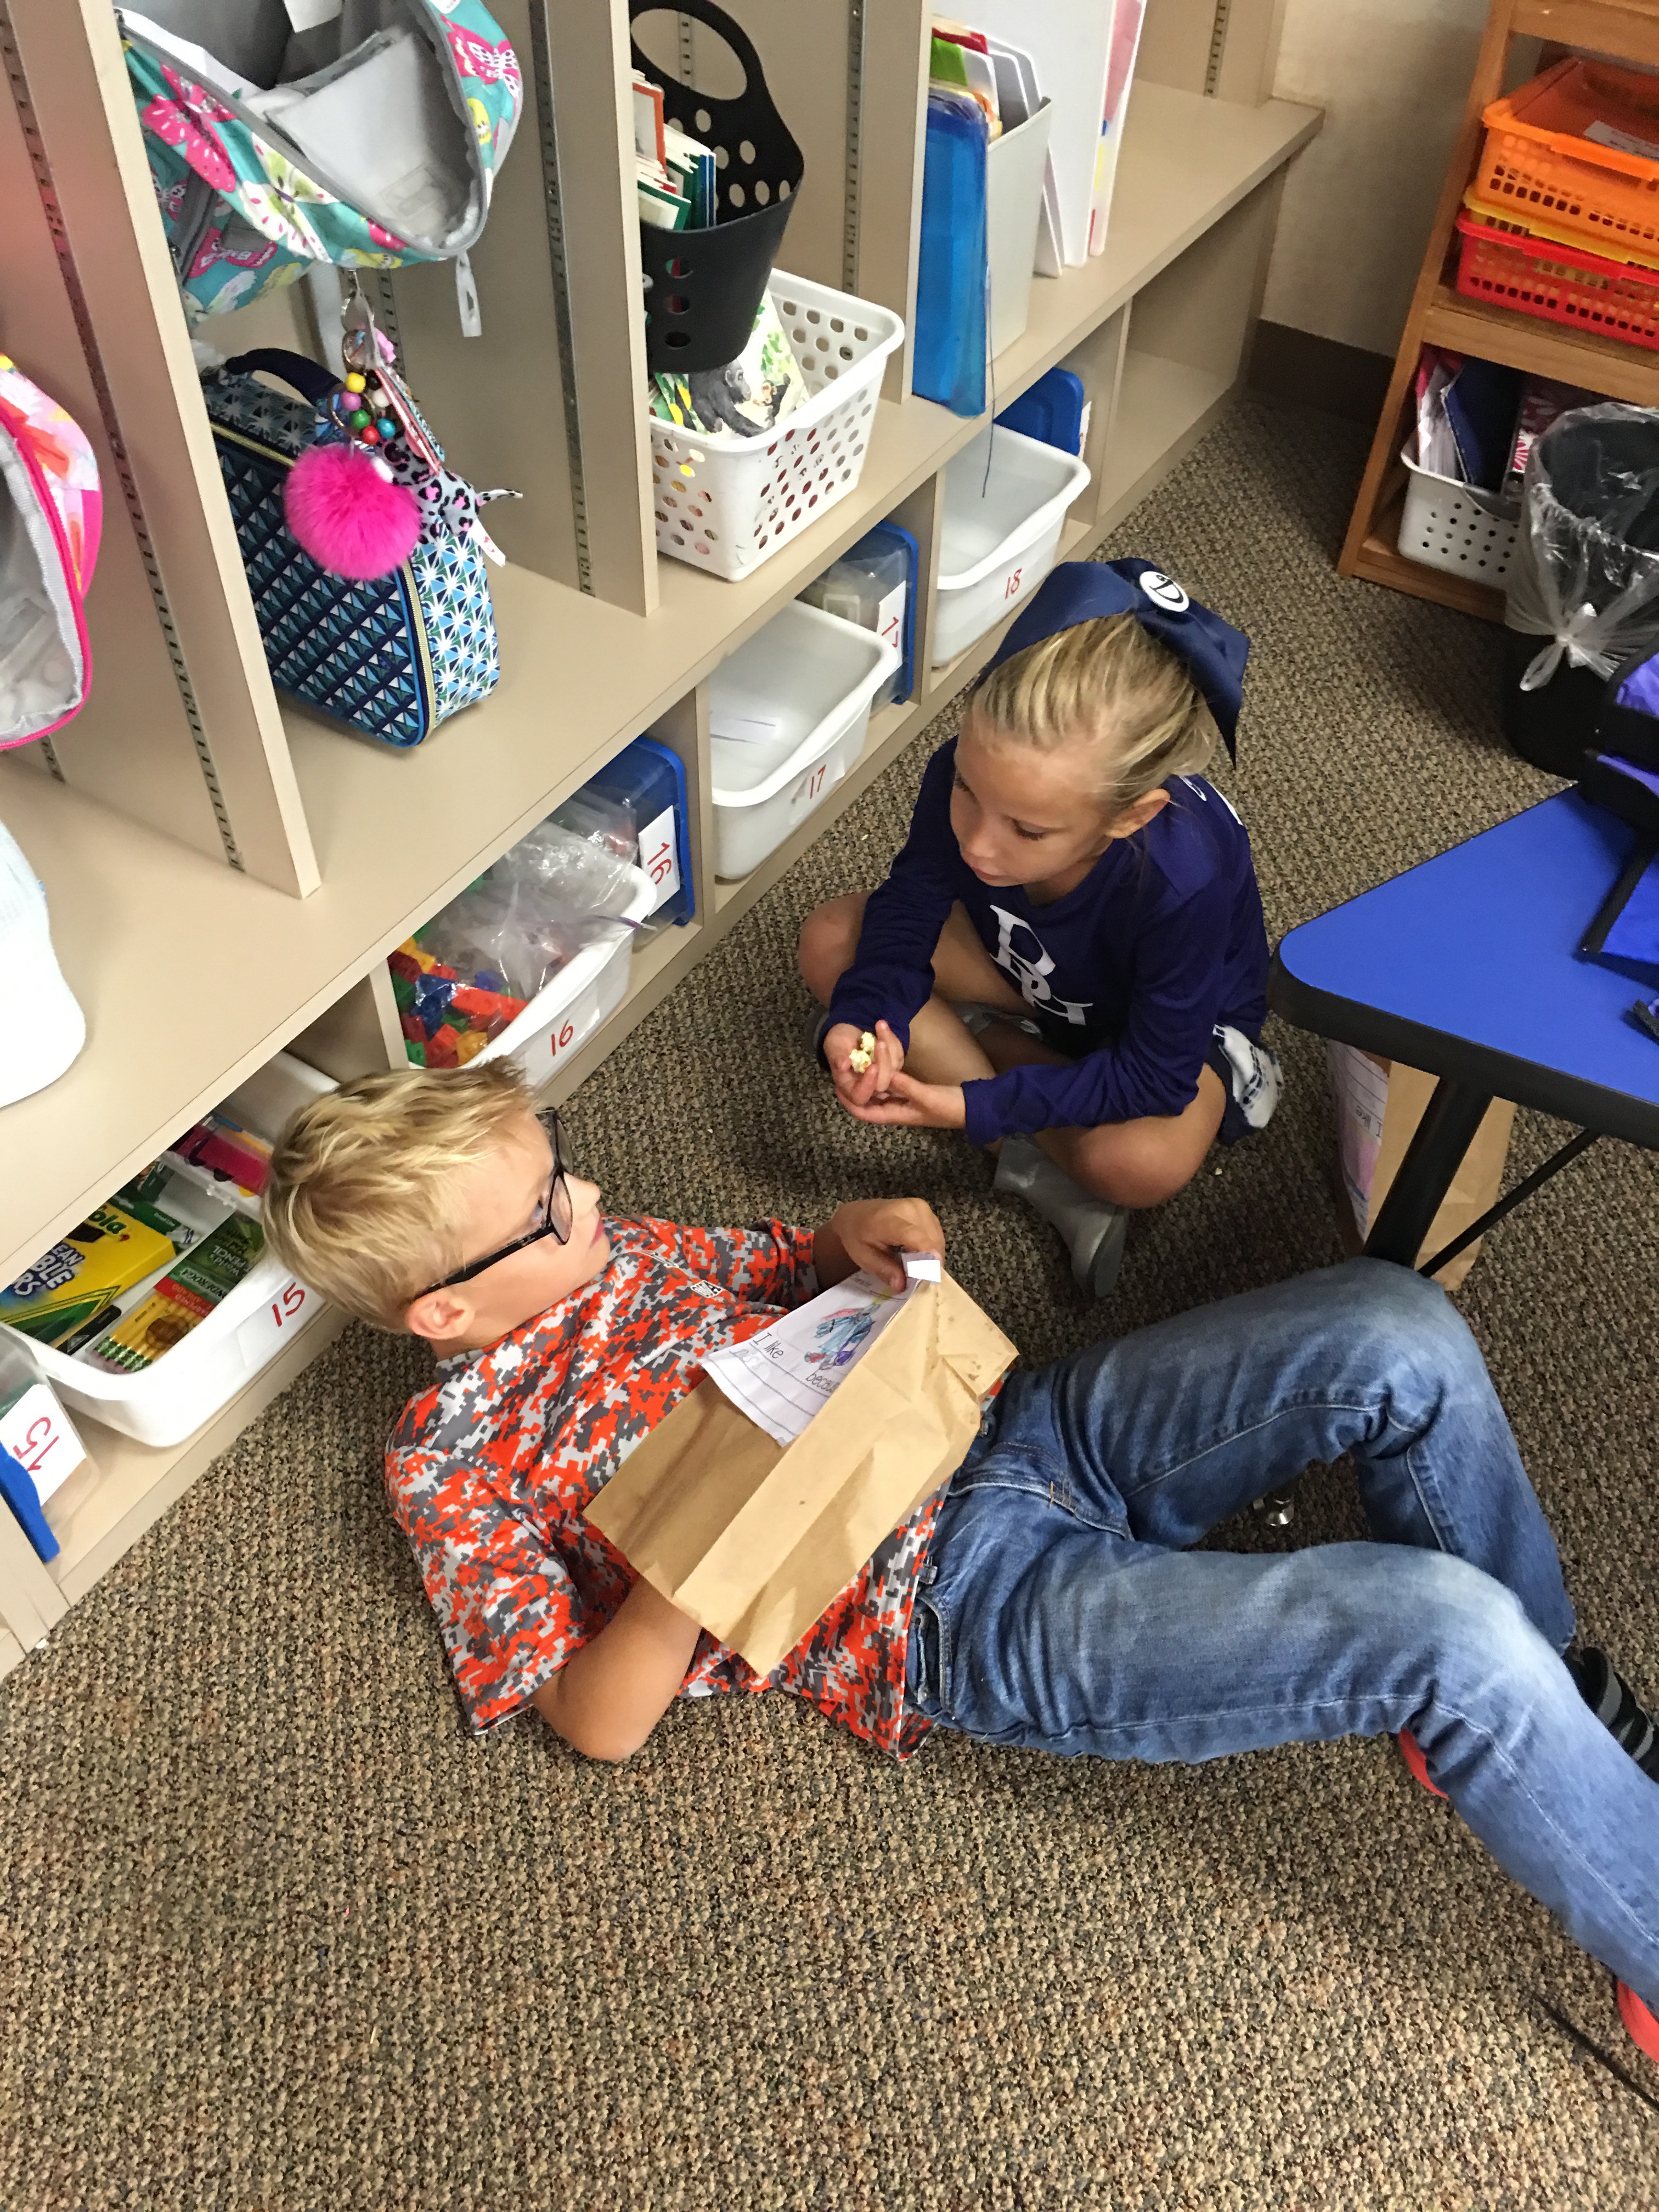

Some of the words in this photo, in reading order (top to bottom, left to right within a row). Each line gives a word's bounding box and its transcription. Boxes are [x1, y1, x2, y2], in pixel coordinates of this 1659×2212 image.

[1005, 568, 1022, 599] 18
[810, 764, 826, 799] 17
[647, 842, 673, 885] 16
[550, 1019, 574, 1057] 16
[87, 1210, 127, 1234] ola
[30, 1254, 72, 1289] BLE
[51, 1243, 84, 1266] EAN
[180, 1268, 227, 1300] NDEROGA
[271, 1282, 306, 1328] 15
[763, 1340, 785, 1359] like
[13, 1417, 60, 1472] 15
